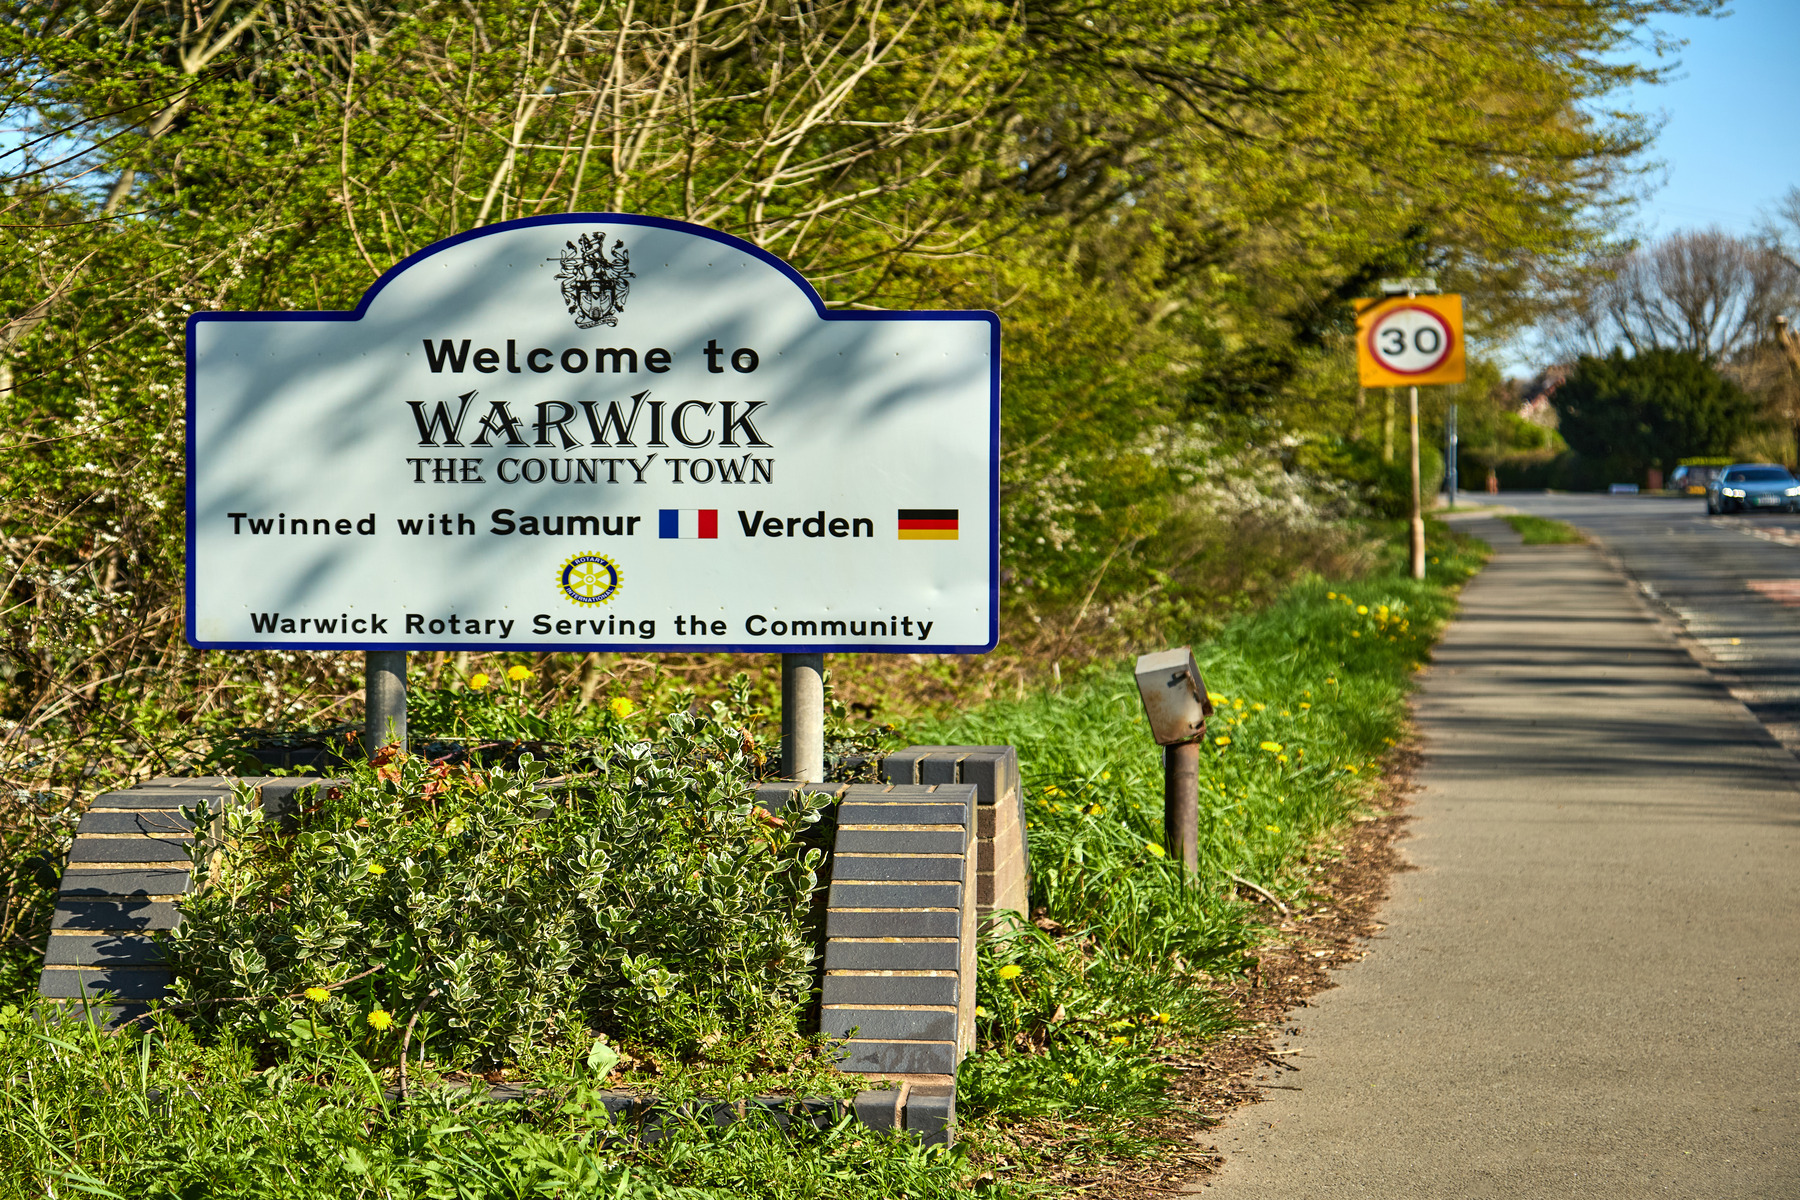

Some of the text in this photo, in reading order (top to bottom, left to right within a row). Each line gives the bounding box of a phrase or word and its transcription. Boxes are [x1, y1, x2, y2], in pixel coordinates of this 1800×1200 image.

[423, 338, 760, 374] Welcome to
[1382, 327, 1441, 356] 30
[406, 389, 774, 452] WARWICK
[406, 452, 775, 485] THE COUNTY TOWN
[227, 508, 875, 538] Twinned with Saumur Verden
[574, 556, 605, 565] ROTARY
[565, 587, 614, 603] INTERNATIONAL
[250, 613, 935, 642] Warwick Rotary Serving the Community
